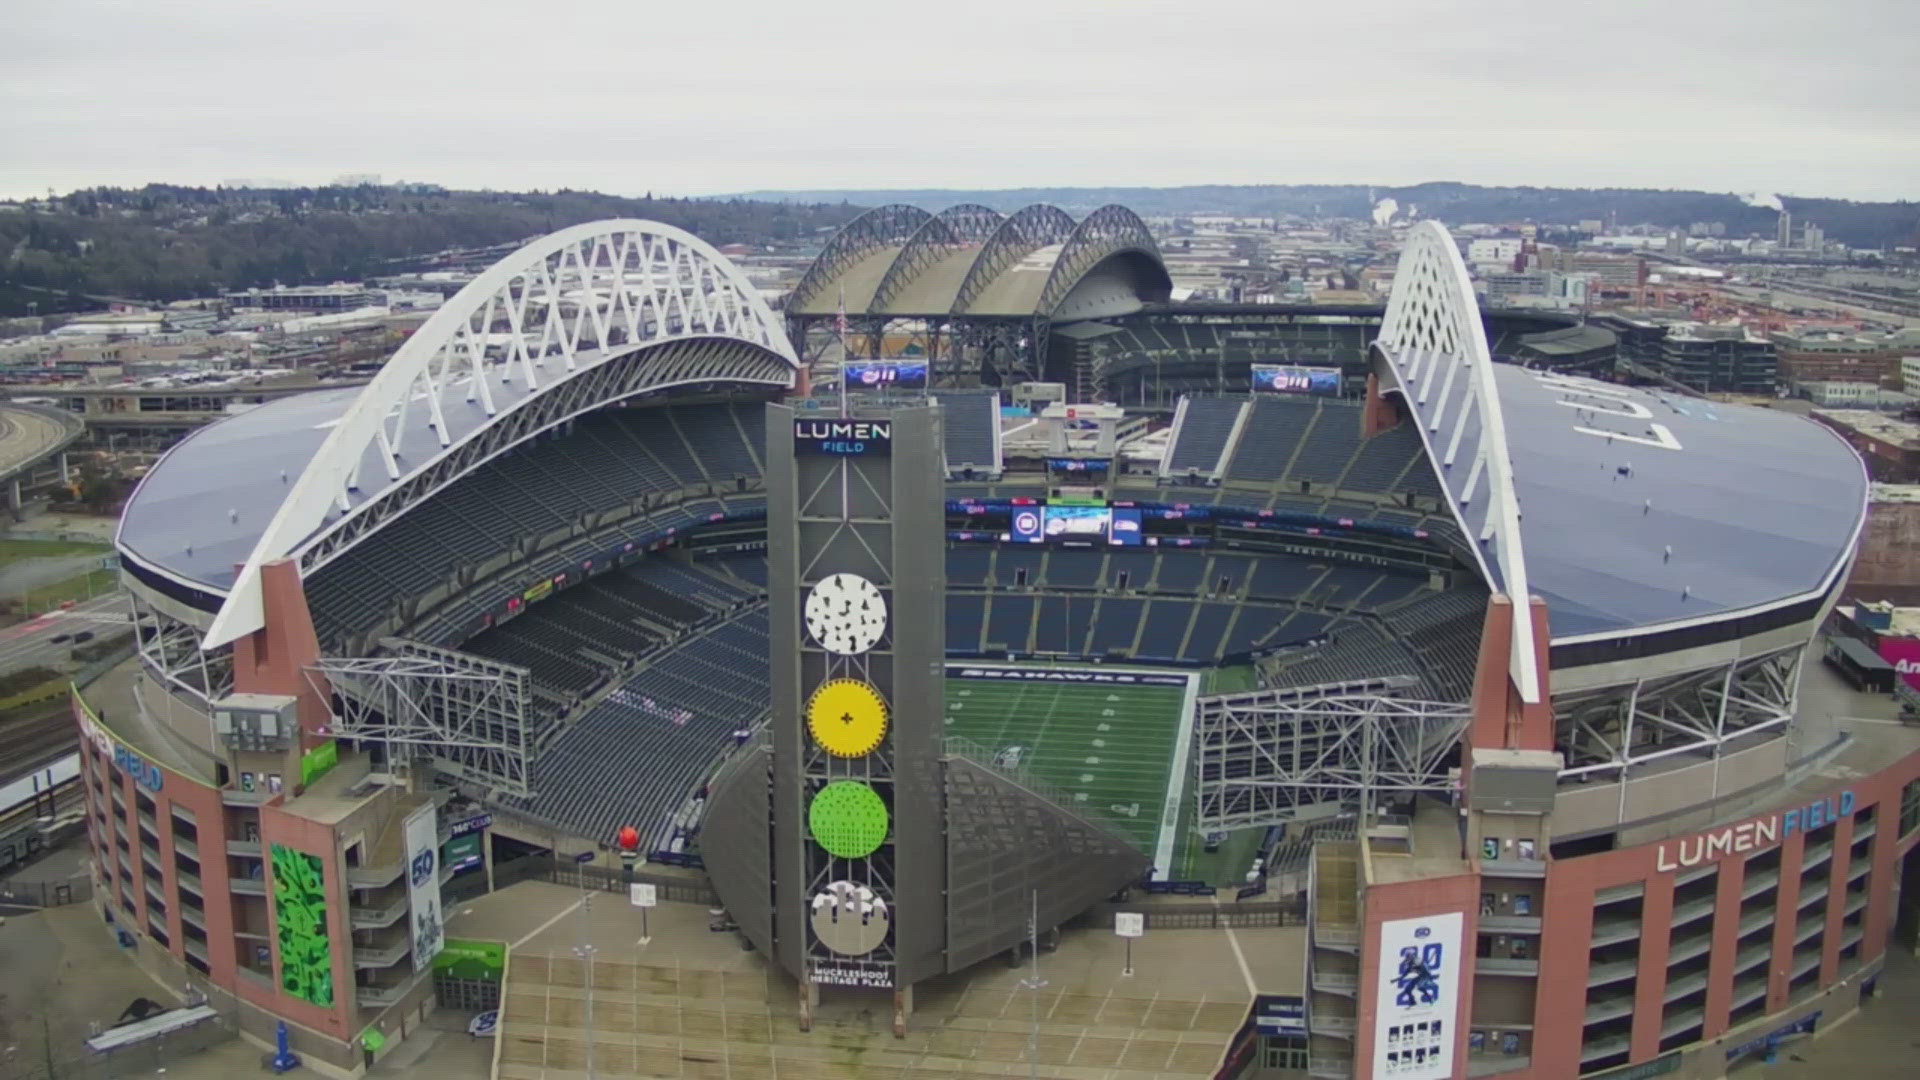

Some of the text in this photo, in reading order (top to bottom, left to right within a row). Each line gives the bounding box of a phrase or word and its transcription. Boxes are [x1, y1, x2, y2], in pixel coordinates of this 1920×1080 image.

[796, 423, 891, 439] LUMEN
[822, 442, 864, 452] FIELD
[961, 669, 1135, 682] SEAHAWKS
[115, 743, 163, 793] FIELD
[1657, 791, 1856, 872] LUMEN FIELD
[810, 974, 894, 988] HERITAGE PLAZA
[814, 968, 889, 980] MUCKLESHOOT
